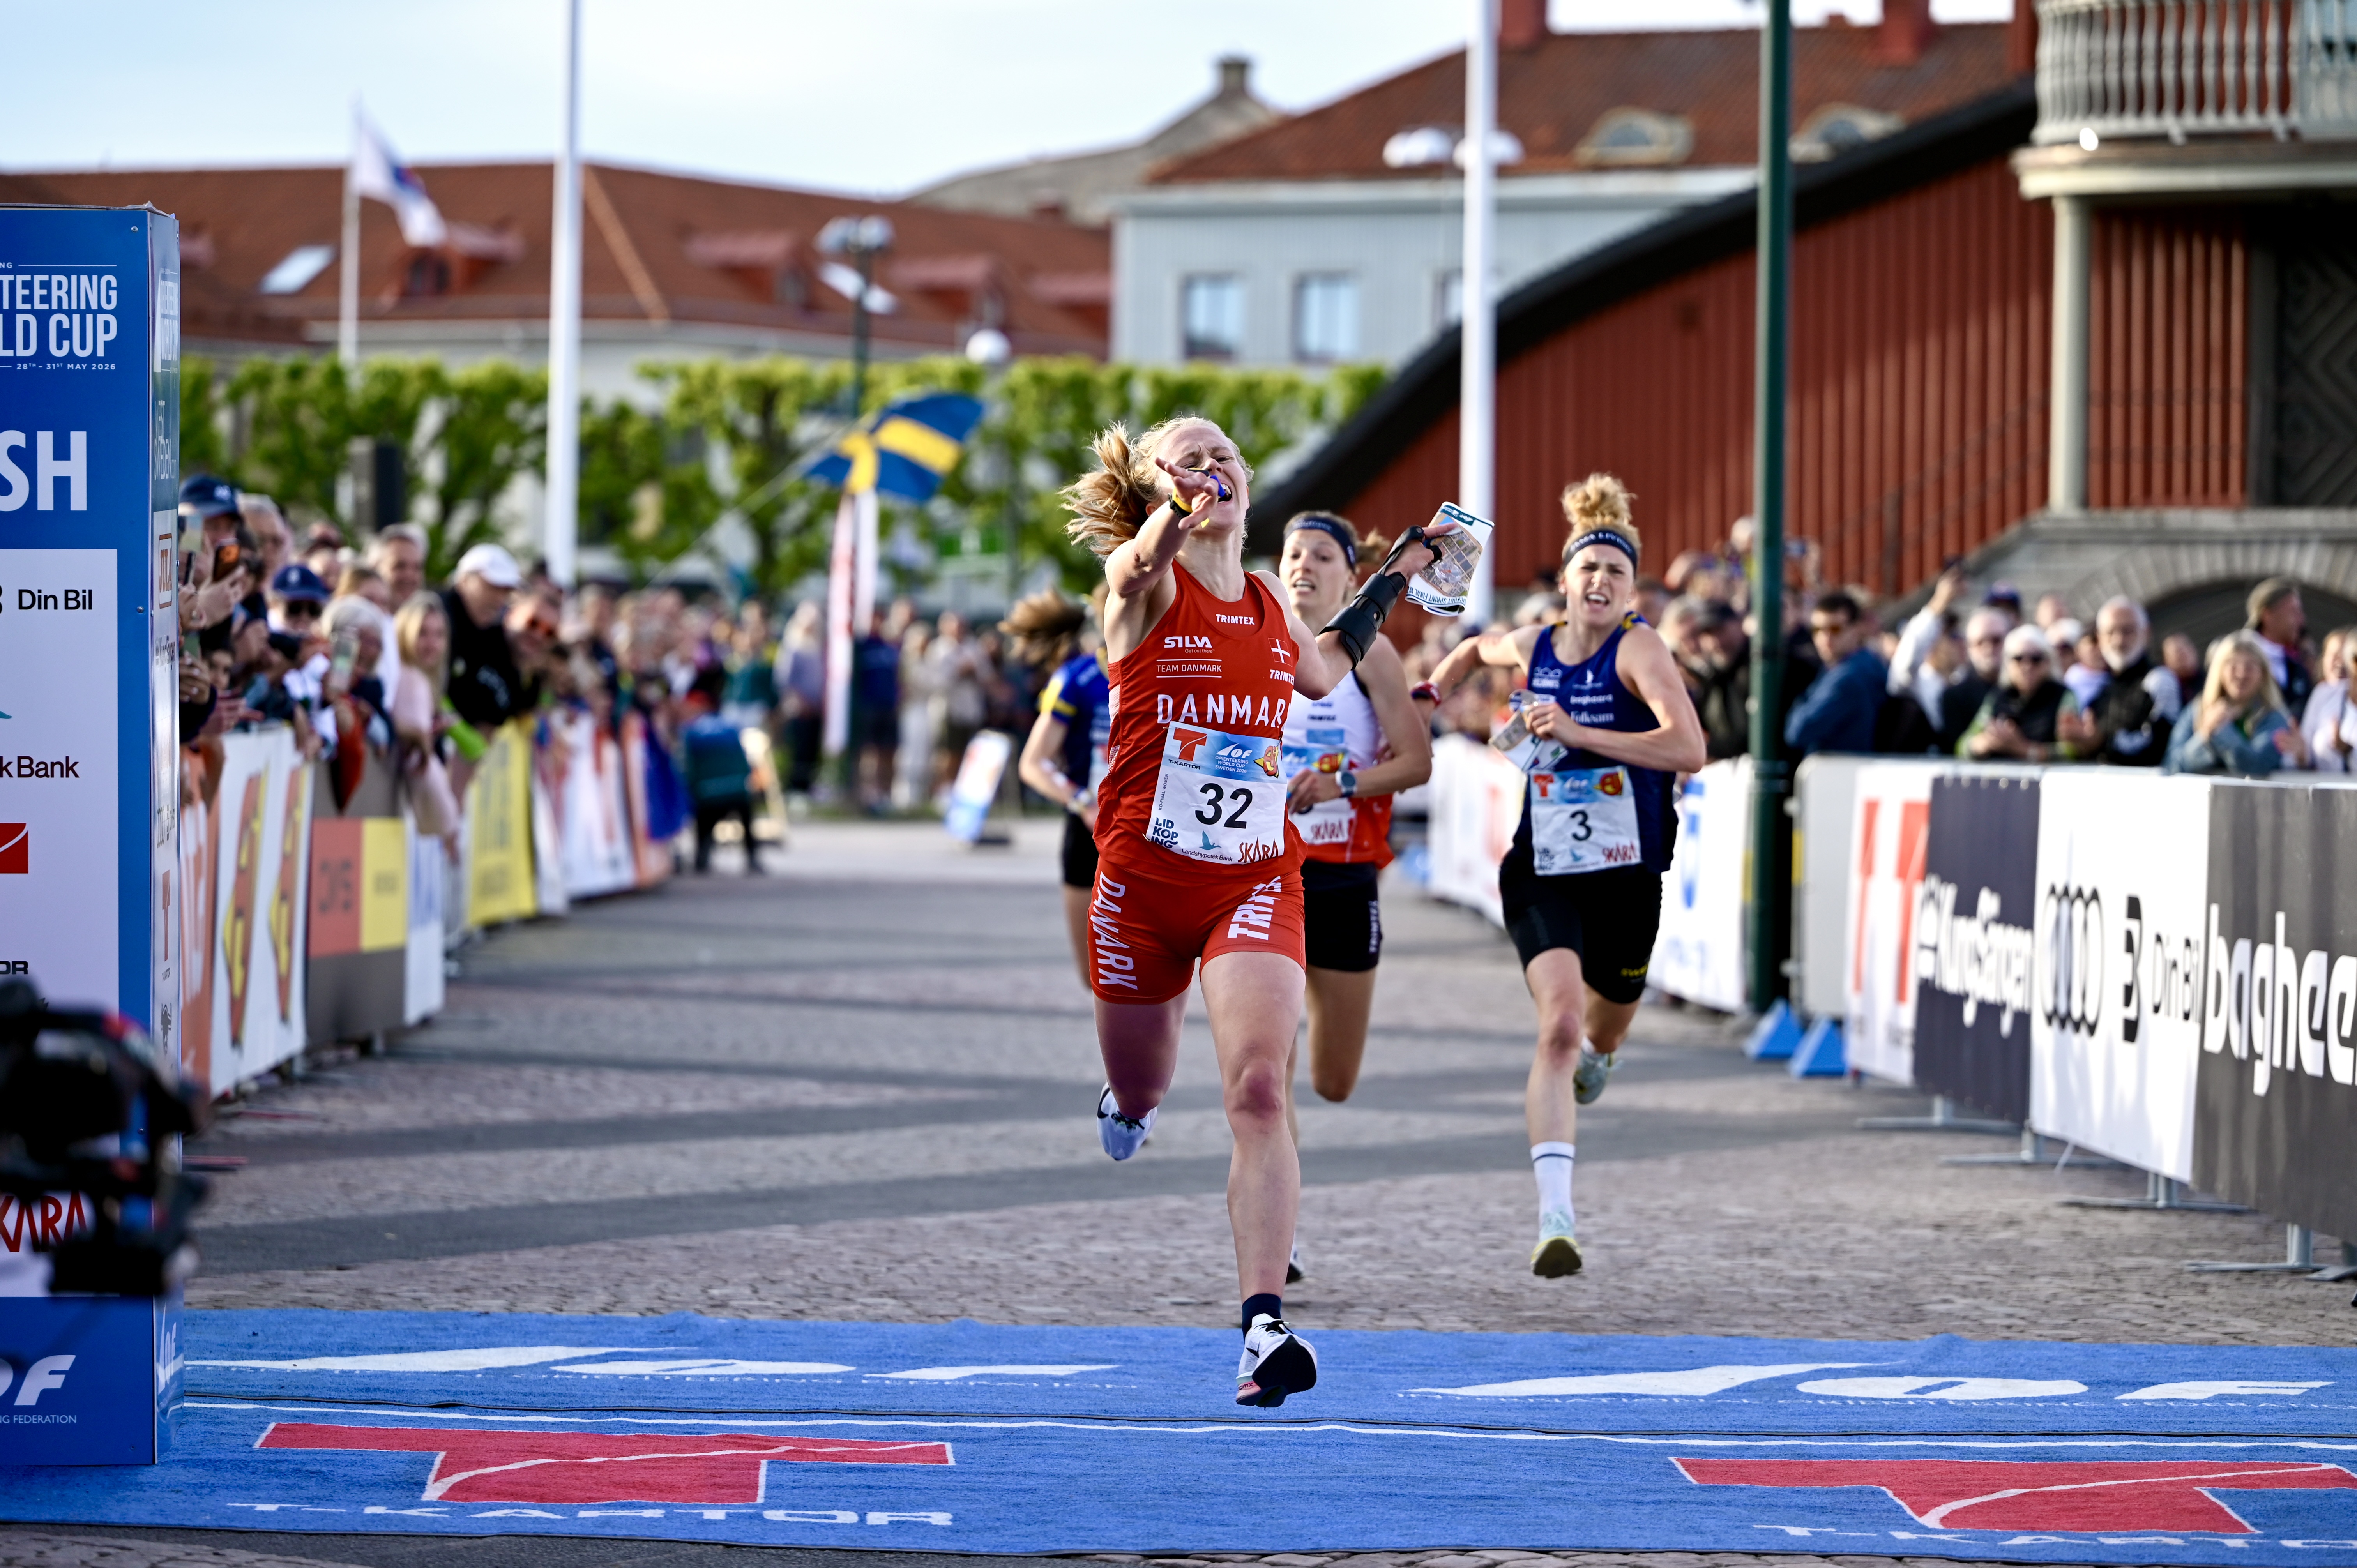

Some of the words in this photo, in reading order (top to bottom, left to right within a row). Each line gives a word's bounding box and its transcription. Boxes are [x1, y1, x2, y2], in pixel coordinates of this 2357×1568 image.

[0, 275, 117, 310] TEERING
[49, 313, 117, 357] CUP
[18, 589, 58, 610] Din
[64, 589, 93, 610] Bil
[1415, 588, 1428, 601] FINAL
[1428, 594, 1447, 604] SPRINT
[1216, 614, 1255, 625] TRIMTEX
[1164, 636, 1212, 648] SILVA
[1181, 664, 1222, 672] DANMARK
[1157, 694, 1291, 730] DANMAR
[18, 756, 79, 778] Bank
[1168, 759, 1201, 770] T-KARTOR
[1215, 756, 1249, 765] ORIENTEERING
[1195, 783, 1253, 829] 32
[1155, 817, 1174, 829] LID
[1570, 809, 1591, 841] 3
[1182, 848, 1219, 860] Landshypotek
[1238, 836, 1279, 863] SKARA
[2152, 932, 2179, 1019] Din
[2183, 936, 2200, 1024] Bil
[2203, 902, 2357, 1097] baghee
[14, 1415, 77, 1423] FEDERATION
[226, 1503, 954, 1526] T-KARTOR
